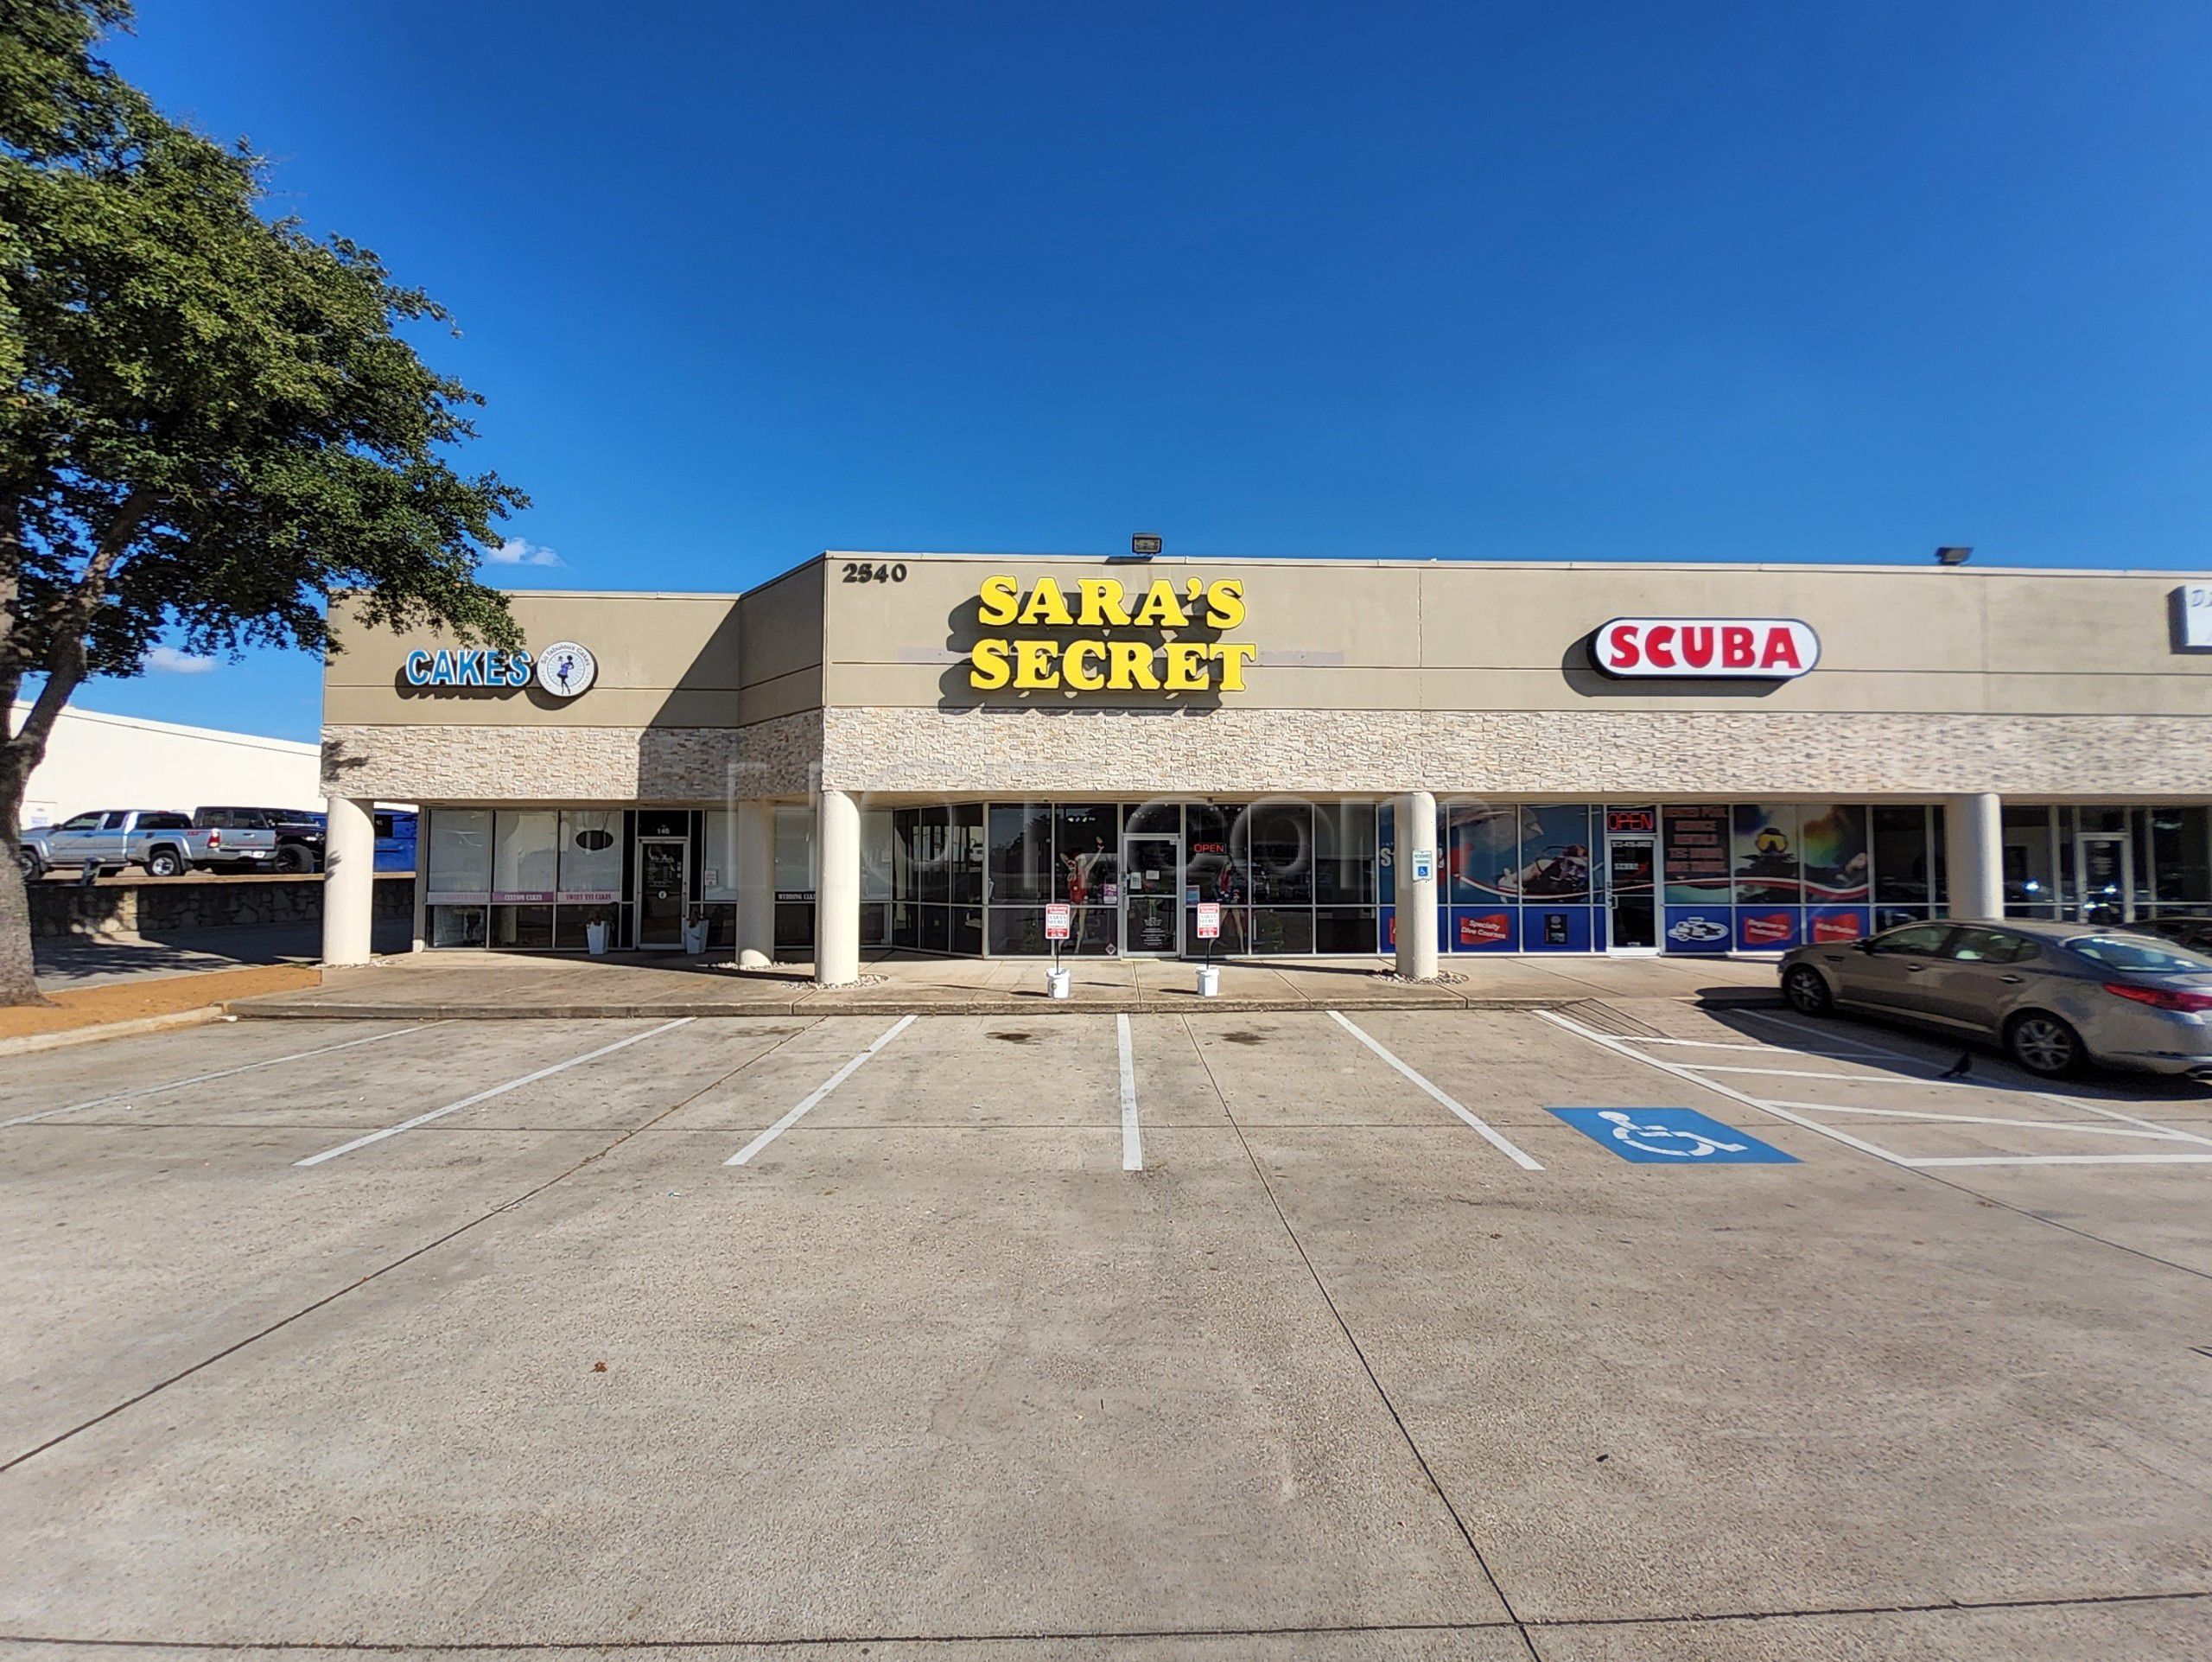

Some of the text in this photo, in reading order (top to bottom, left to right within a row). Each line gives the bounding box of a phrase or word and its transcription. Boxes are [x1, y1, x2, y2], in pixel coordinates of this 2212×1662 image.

[842, 563, 907, 584] 2540
[978, 575, 1247, 629] SARA'S
[1608, 625, 1803, 670] SCUBA
[405, 649, 532, 686] CAKES
[969, 639, 1257, 691] SECRET
[1608, 812, 1654, 831] OPEN
[1193, 844, 1225, 853] OPEN
[1460, 926, 1507, 939] Dive Courses
[1469, 920, 1501, 932] Specialty
